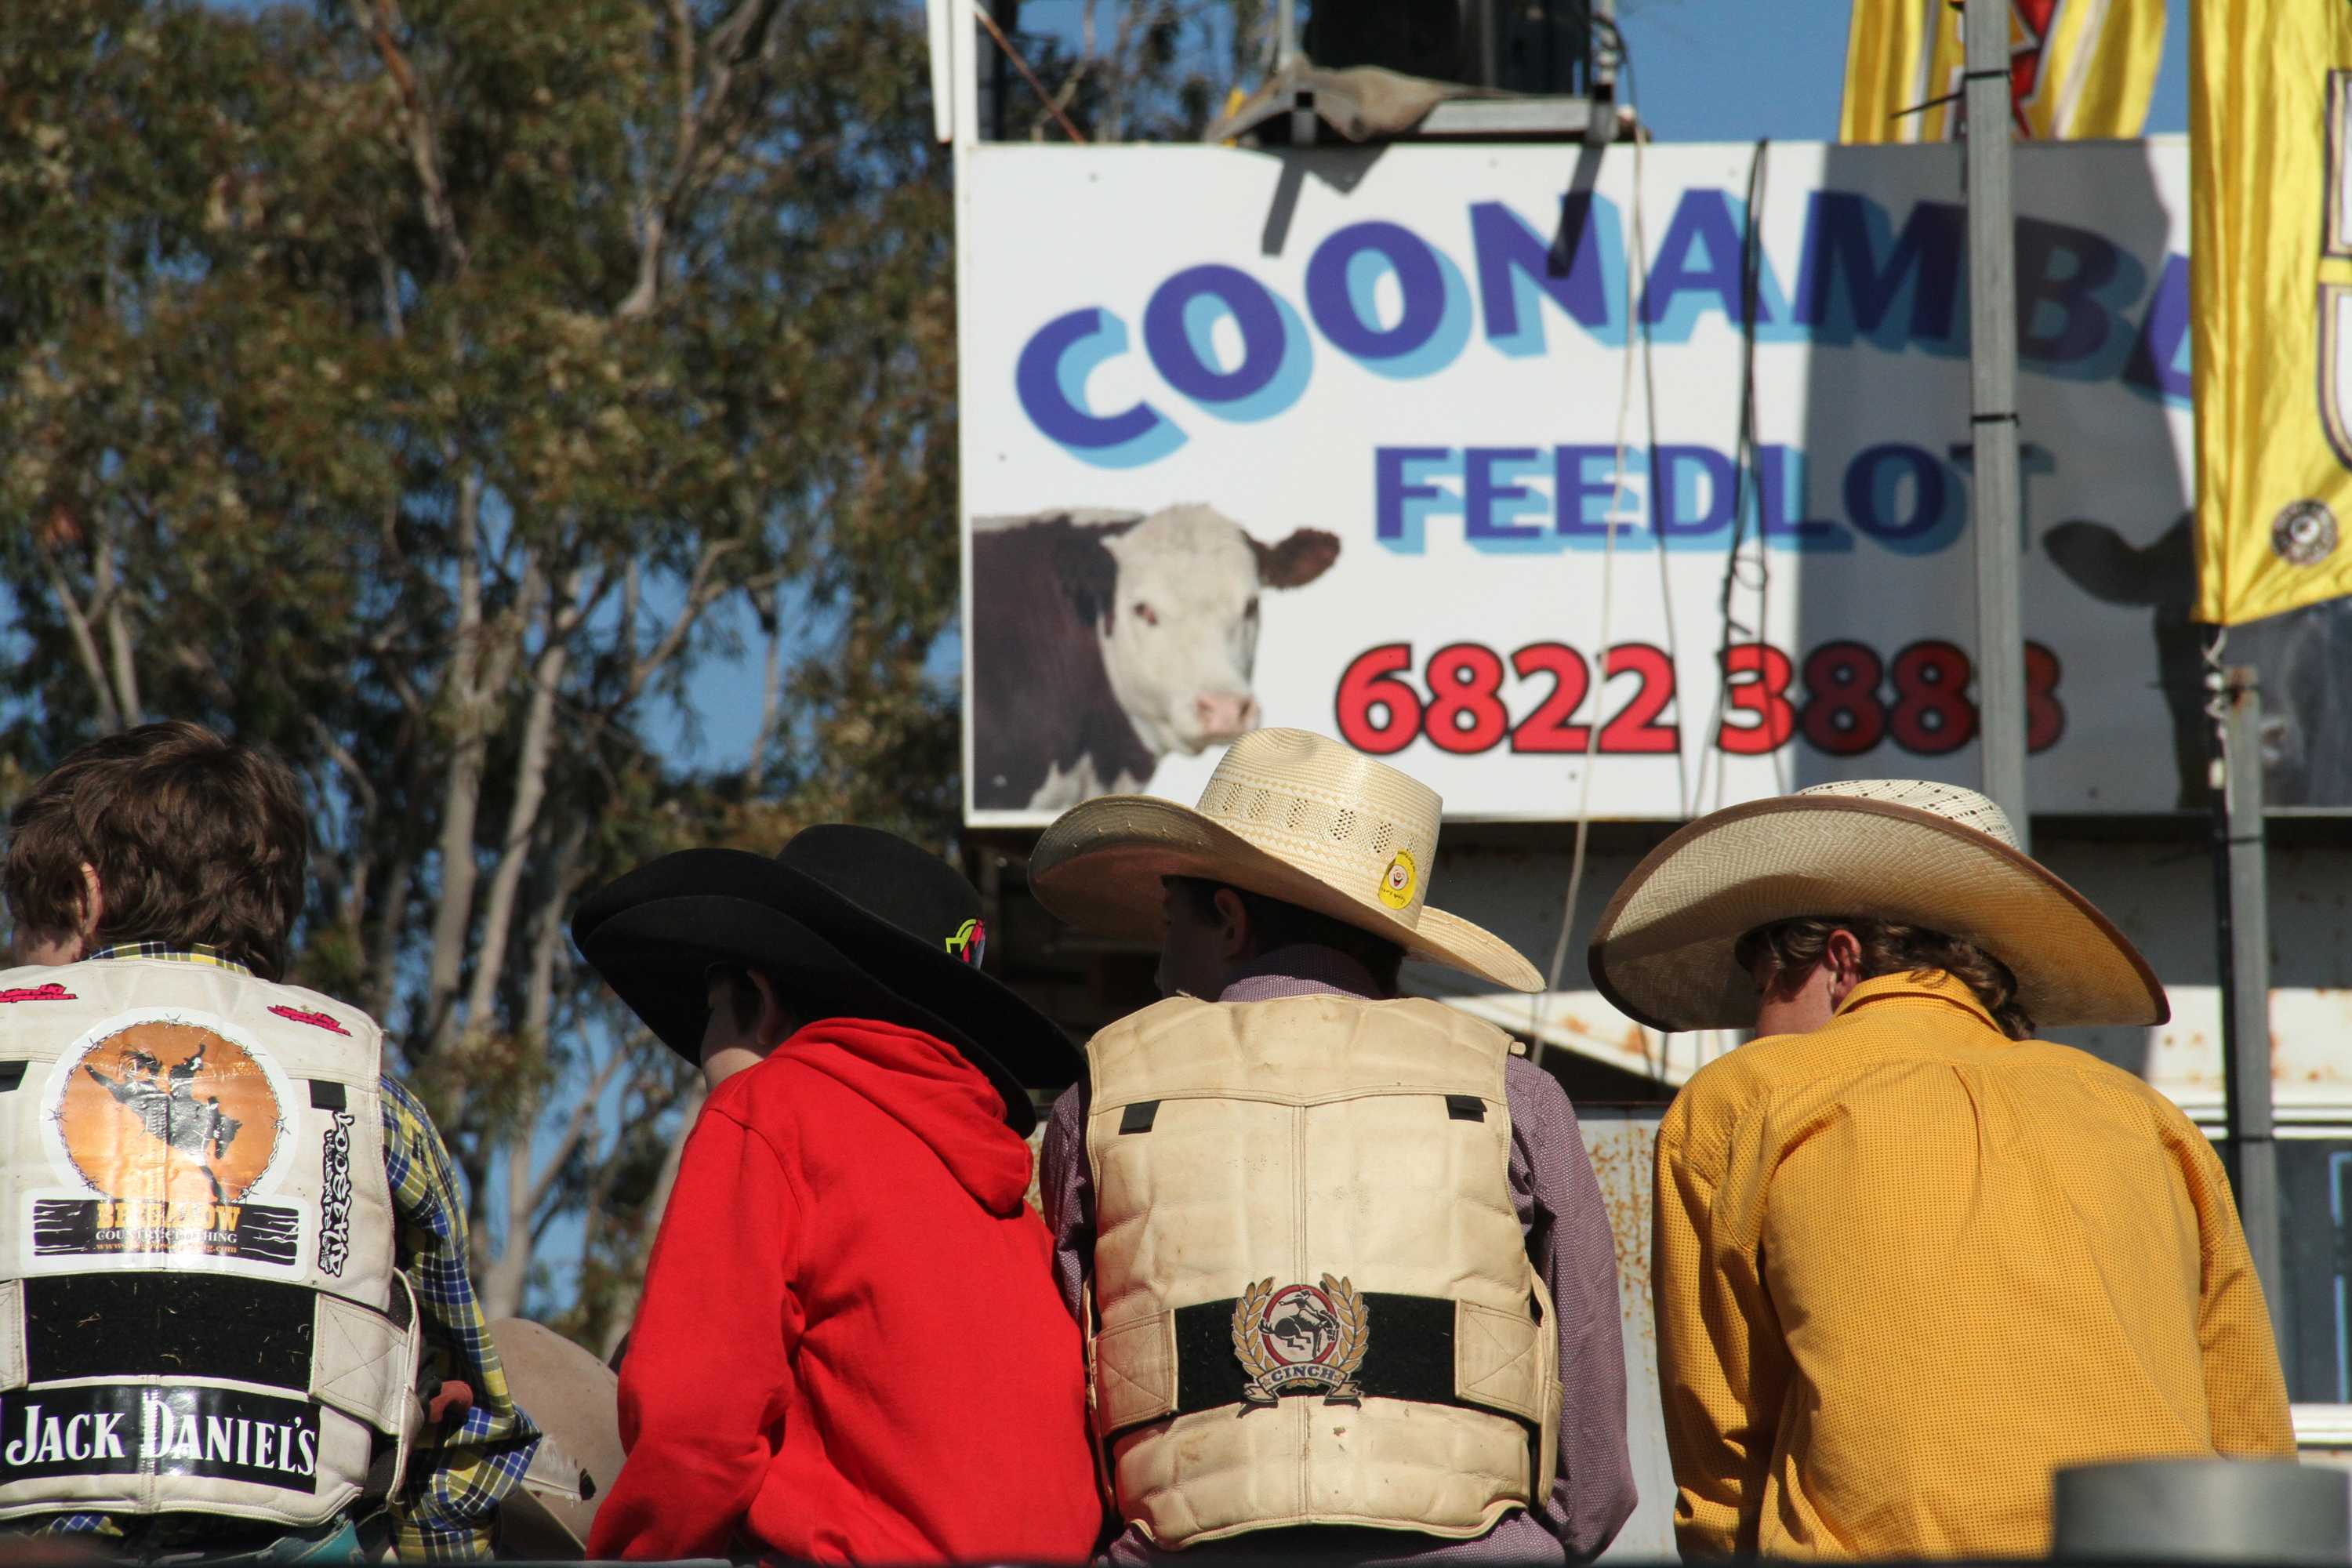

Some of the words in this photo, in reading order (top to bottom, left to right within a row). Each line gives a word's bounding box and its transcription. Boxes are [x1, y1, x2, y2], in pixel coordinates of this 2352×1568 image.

[1374, 443, 2056, 555] FEEDLO
[1334, 641, 1682, 757] 6822
[1271, 1365, 1334, 1382] CINCH
[5, 1405, 126, 1466] JACK
[142, 1397, 316, 1476] DANIEL'S
